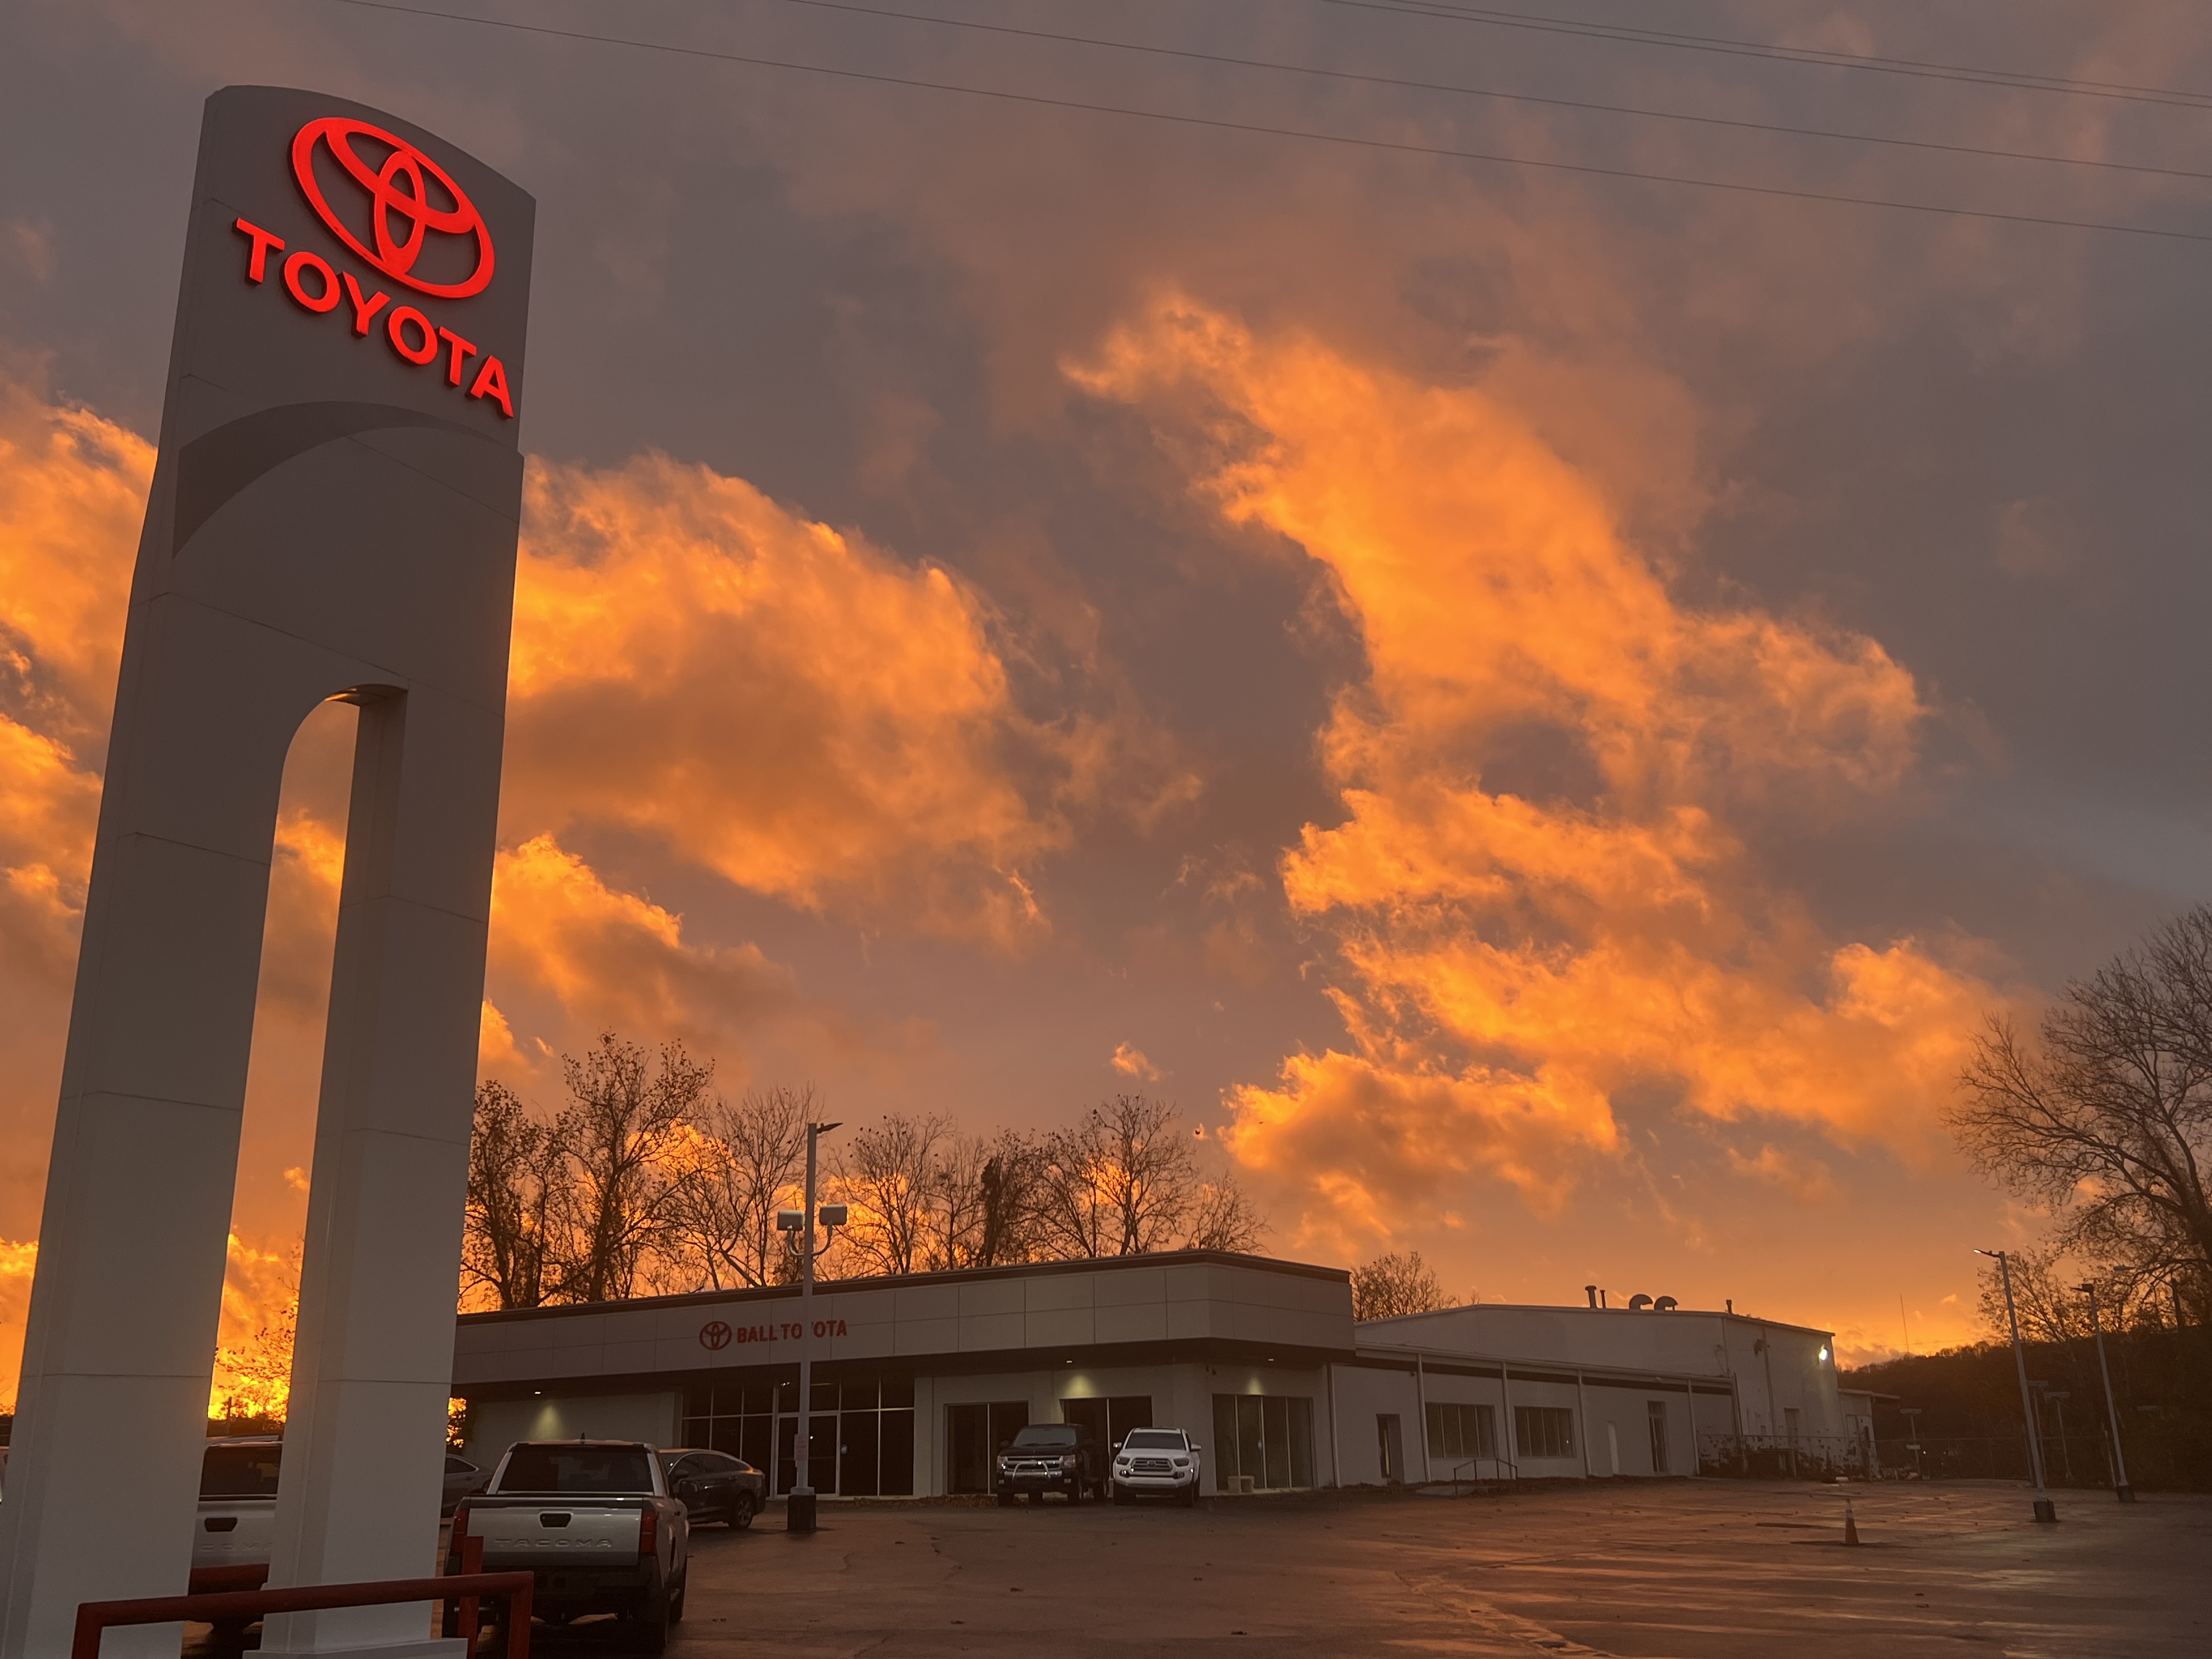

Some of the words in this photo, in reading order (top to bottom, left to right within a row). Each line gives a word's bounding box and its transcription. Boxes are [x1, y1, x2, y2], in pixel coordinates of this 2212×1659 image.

[233, 217, 514, 417] TOYOTA
[737, 1325, 778, 1344] BALL
[780, 1319, 848, 1340] TOOTA
[493, 1538, 612, 1548] TACOMA
